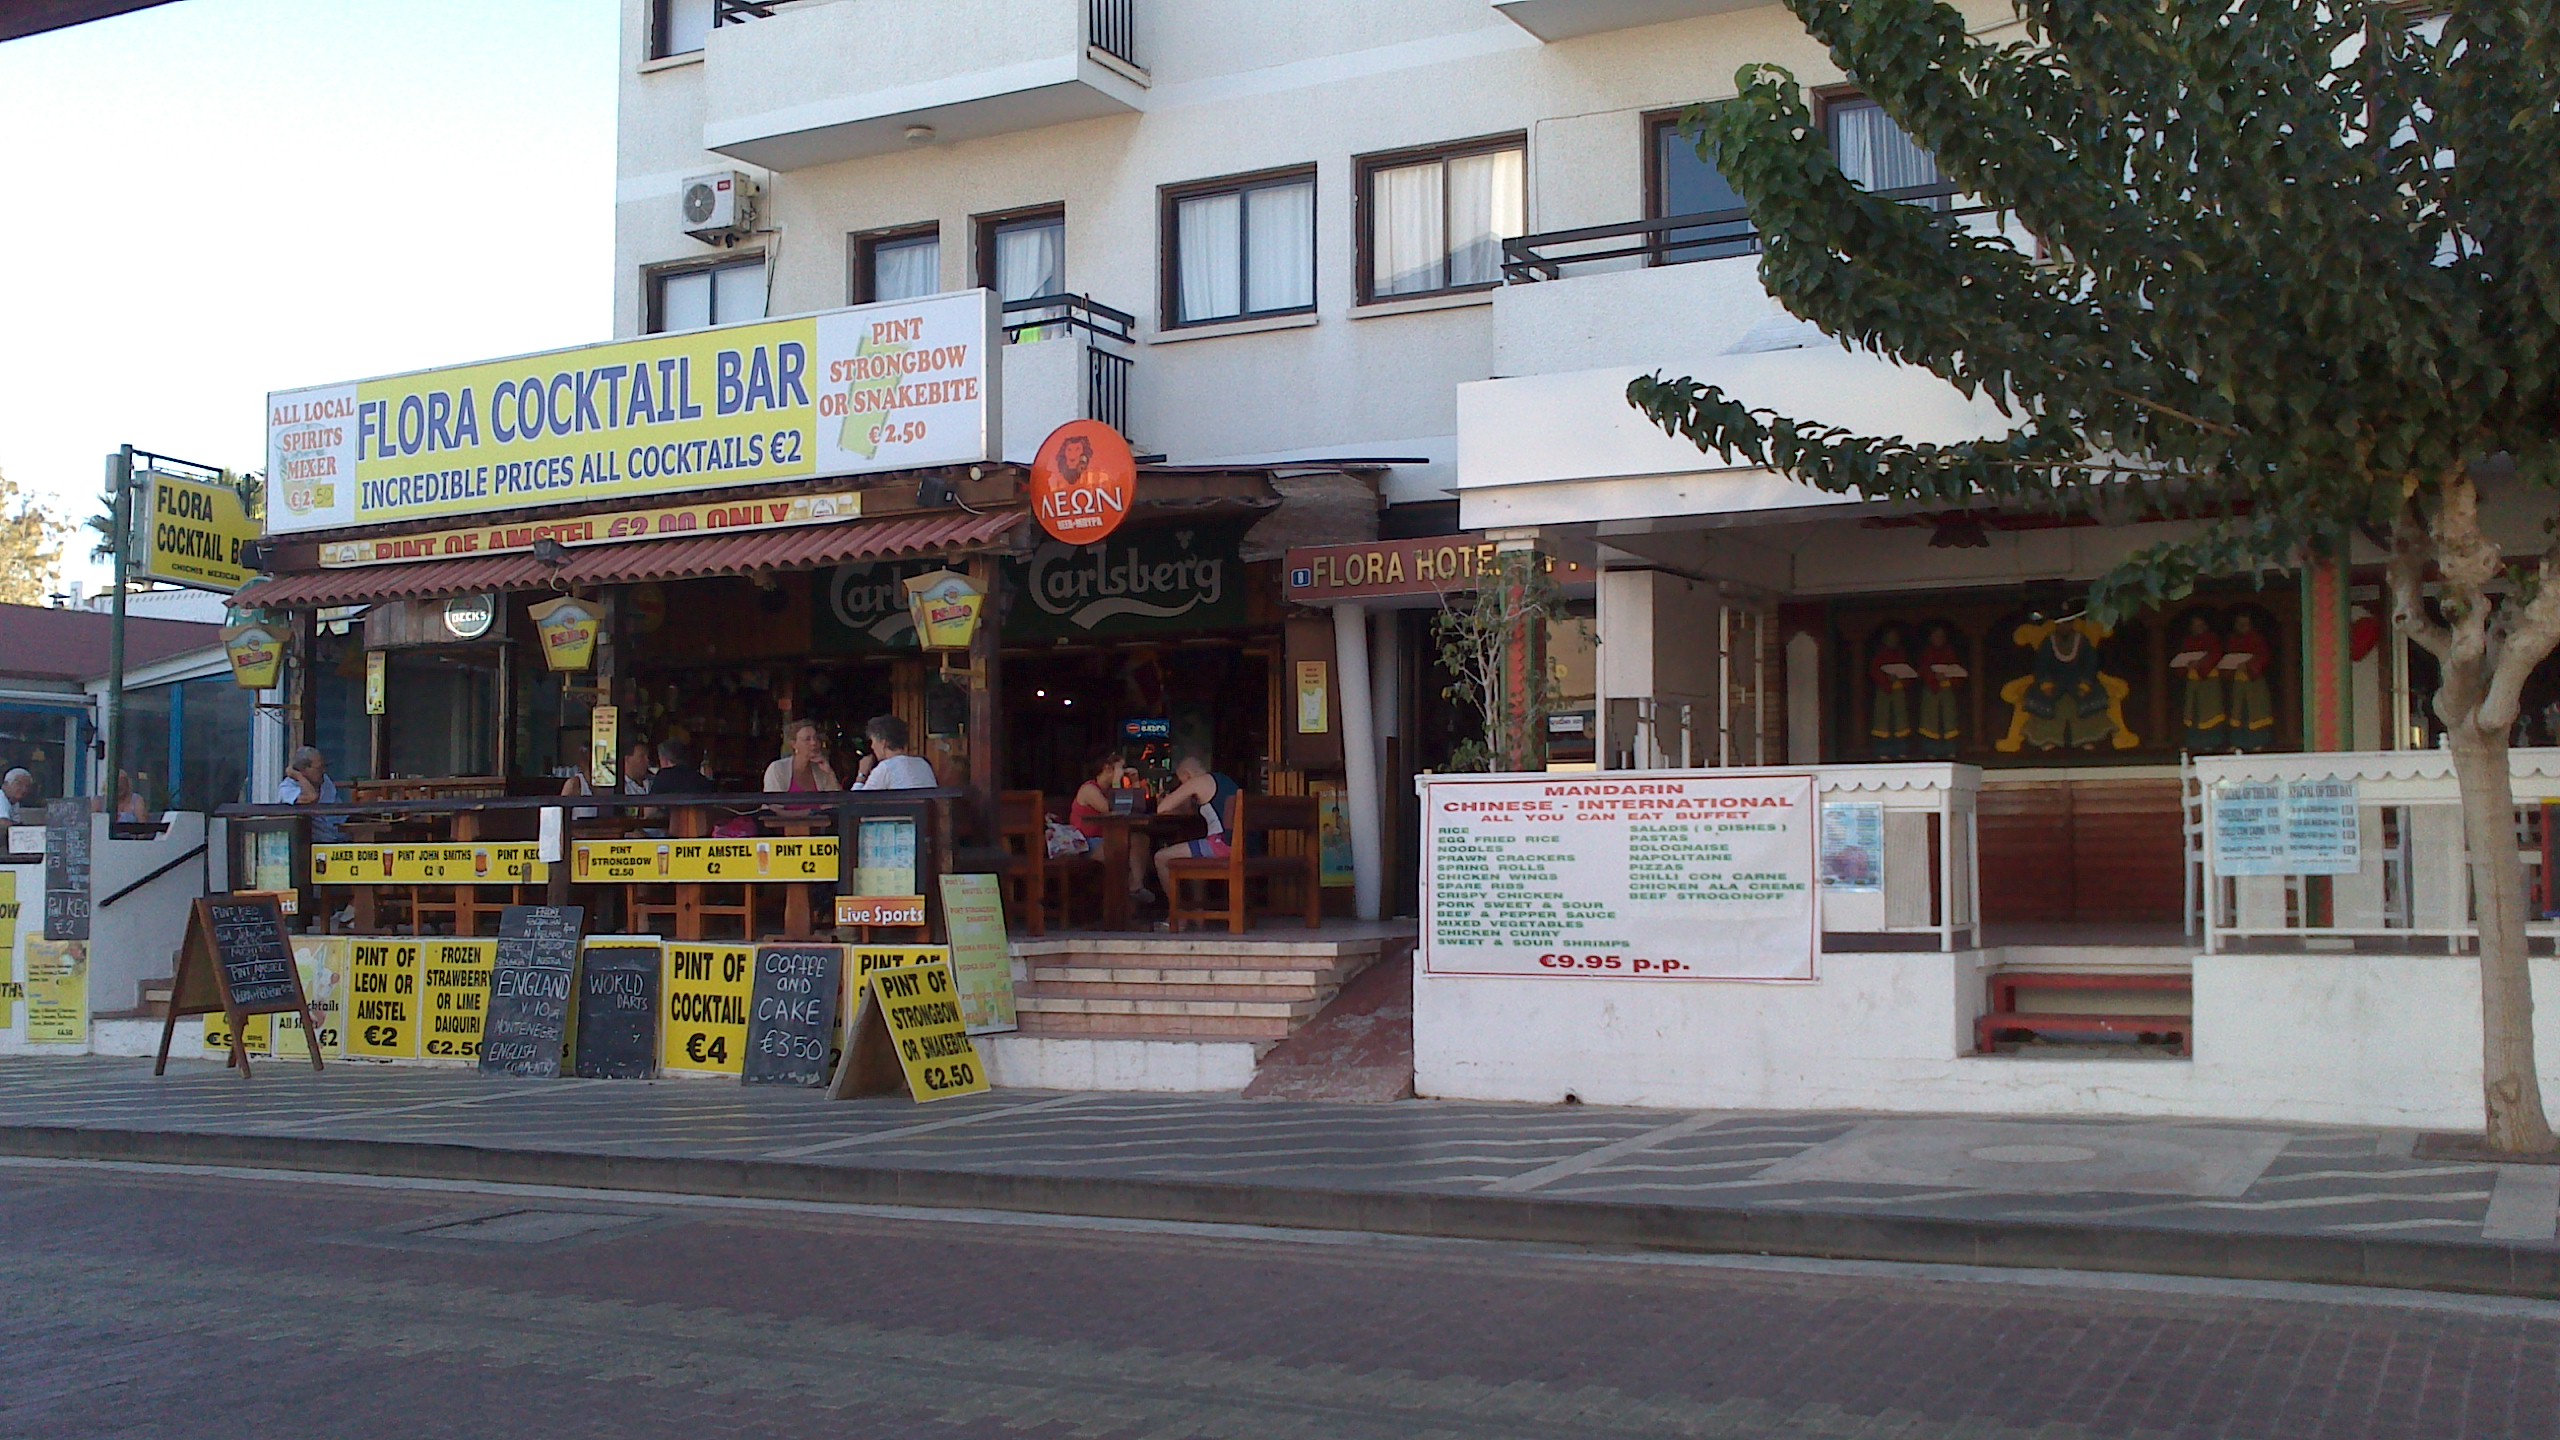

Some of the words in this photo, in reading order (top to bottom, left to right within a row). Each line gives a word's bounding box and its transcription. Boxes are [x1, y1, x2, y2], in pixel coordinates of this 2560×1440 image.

[872, 316, 924, 345] PINT
[830, 344, 967, 383] STRONGBOW
[358, 388, 480, 461] FLORA
[491, 357, 701, 443] COCKTAIL
[717, 342, 810, 416] BAR
[819, 392, 849, 417] OR
[854, 377, 978, 414] SNAKEBITE
[272, 406, 300, 426] ALL
[304, 397, 355, 422] LOCAL
[282, 426, 343, 452] SPIRITS
[286, 456, 338, 480] MIXER
[361, 466, 488, 510] INCREDIBLE
[495, 456, 573, 494] PRICES
[580, 451, 621, 485] ALL
[628, 434, 763, 478] COCKTAILS
[770, 430, 802, 464] €2
[157, 484, 213, 522] FLORA
[1042, 486, 1124, 520] ΛΕΩΝ
[376, 538, 436, 560] PINT
[445, 534, 479, 554] OF
[707, 504, 790, 529] ONLY
[157, 523, 224, 562] COCKTAIL
[1028, 542, 1223, 614] Carlsberg
[1312, 551, 1406, 588] FLORA
[1544, 785, 1684, 796] MANDARIN
[1444, 801, 1553, 812] CHINESE
[1578, 798, 1794, 810] INTERNATIONAL
[1481, 814, 1514, 822] ALL
[1526, 814, 1564, 822] YOU
[1576, 814, 1616, 822] CAN
[1628, 812, 1664, 820] EAT
[1676, 812, 1750, 820] BUFFET
[1630, 834, 1688, 842] PASTAS
[1718, 824, 1776, 832] DISHES
[775, 844, 804, 856] PINT
[809, 844, 840, 856] LEON
[1438, 836, 1466, 844] EGG
[1630, 844, 1729, 852] BOLOGNAISE
[358, 850, 378, 861] BOMB
[398, 850, 415, 861] PINT
[419, 850, 440, 861] JOHN
[443, 850, 472, 860] SMITHS
[497, 849, 518, 860] PINT
[592, 856, 652, 866] STRONGBOW
[610, 846, 632, 856] PINT
[675, 846, 702, 858] PINT
[708, 845, 752, 858] AMSTEL
[608, 867, 634, 876] €2.50
[708, 862, 722, 874] €2
[801, 861, 816, 874] €2
[838, 905, 870, 924] Live
[874, 905, 924, 926] Sports
[1490, 920, 1584, 928] VEGETABLES
[1438, 938, 1484, 946] SWEET
[1563, 940, 1630, 948] SHRIMPS
[355, 946, 387, 968] PINT
[396, 947, 416, 968] OF
[441, 946, 480, 964] FROZEN
[1539, 954, 1622, 969] €9.95
[1632, 958, 1690, 974] p.p.
[674, 952, 714, 980] PINT
[723, 952, 746, 982] OF
[354, 974, 388, 994] LEON
[394, 974, 413, 994] OR
[426, 970, 492, 988] STRAWBERRY
[496, 970, 571, 1000] ENGLAND
[590, 974, 644, 996] WORLD
[881, 973, 922, 998] PINT
[927, 970, 946, 994] OF
[357, 1002, 406, 1022] AMSTEL
[436, 994, 451, 1009] OR
[456, 994, 480, 1010] LIME
[616, 994, 648, 1010] DARTS
[672, 992, 746, 1025] COCKTAIL
[758, 998, 820, 1025] CAKE
[434, 1016, 480, 1033] DAIQUIRI
[892, 1001, 960, 1030] STRONGBOW
[320, 1029, 338, 1046] €2
[364, 1025, 398, 1048] €2
[902, 1039, 922, 1062] OR
[921, 1031, 972, 1059] SNAKEBITE
[488, 1042, 538, 1062] ENGLISH
[686, 1033, 728, 1064] €4
[924, 1063, 974, 1090] €2.50
